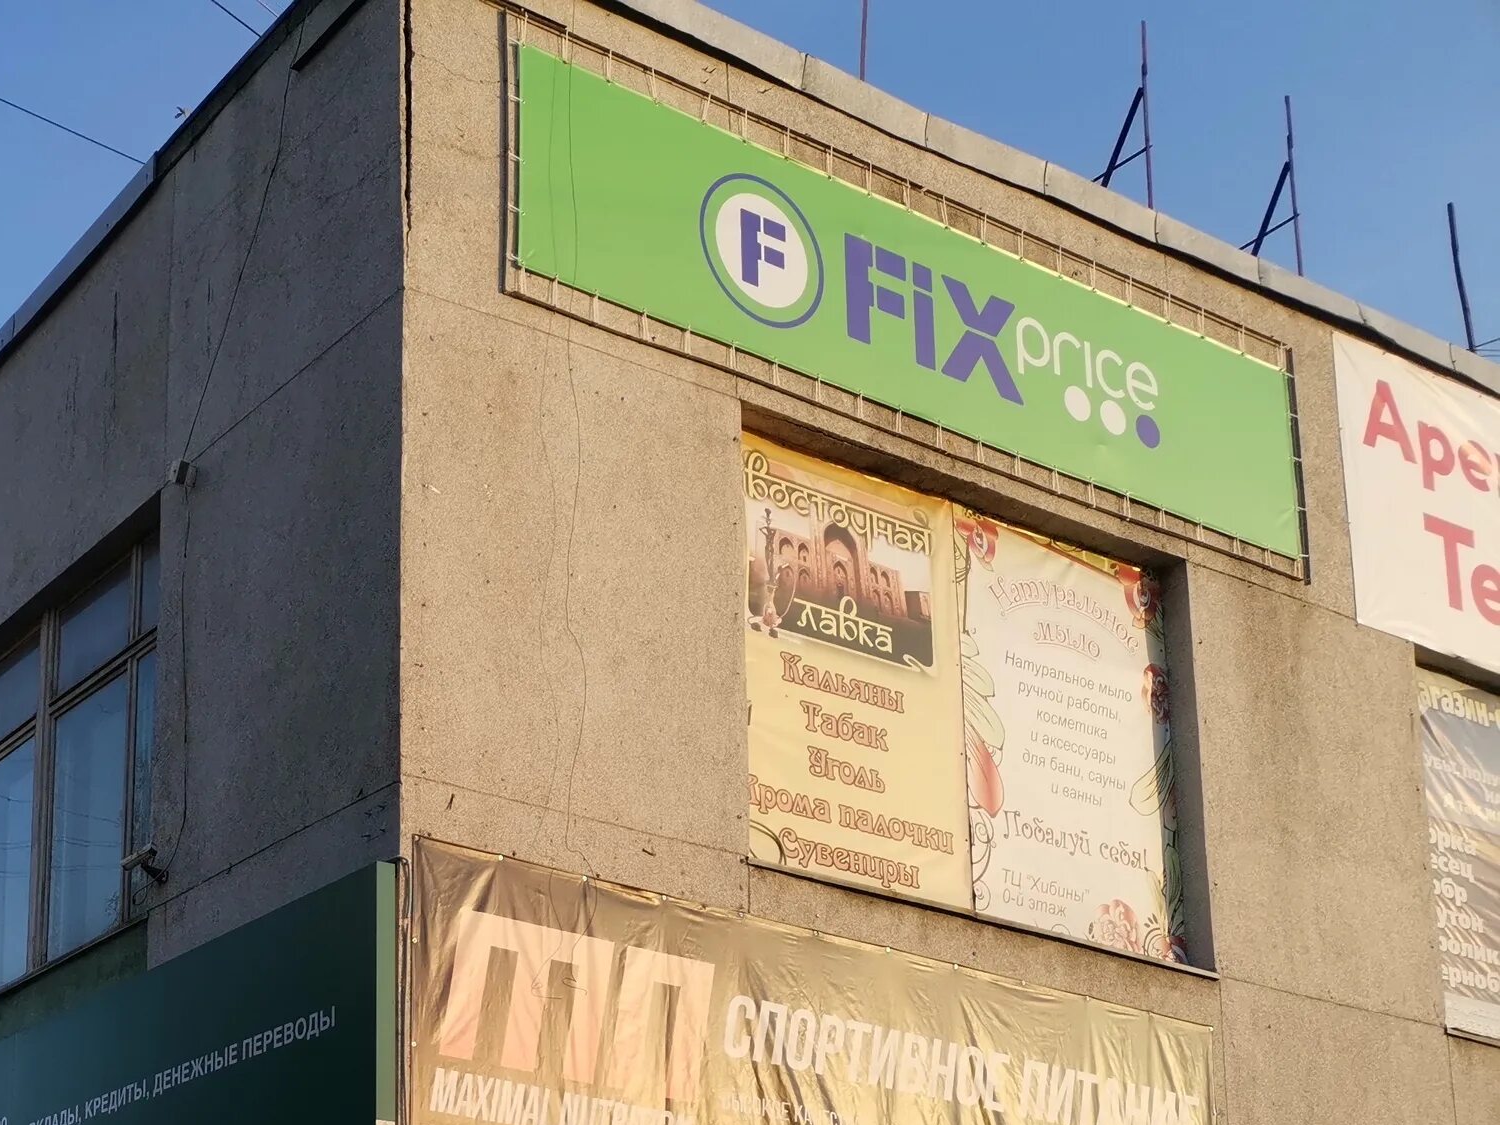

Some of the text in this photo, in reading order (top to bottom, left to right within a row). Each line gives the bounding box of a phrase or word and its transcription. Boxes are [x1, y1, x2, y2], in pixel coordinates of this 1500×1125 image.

[1015, 317, 1158, 411] price
[1363, 379, 1500, 492] Аре
[988, 575, 1140, 656] Натуральное
[780, 651, 904, 713] Кальяны
[1004, 650, 1133, 703] Натуральное мыло
[1018, 681, 1122, 723] ручной работы,
[800, 700, 889, 752] Табак
[1030, 730, 1116, 765] и аксессуары
[1036, 709, 1108, 740] косметика
[807, 745, 885, 793] Уголь
[1022, 748, 1126, 791] для бани, сауны
[1051, 783, 1102, 807] и ванны
[838, 803, 954, 856] палочки
[1003, 810, 1150, 872] Побалуй себя!
[779, 827, 920, 889] Сувениры
[1002, 868, 1022, 890] ТЦ
[1002, 888, 1067, 918] 0-й этаж
[85, 1078, 150, 1121] КРЕДИТЫ,
[152, 1043, 239, 1098] ДЕНЕЖНЫЕ
[242, 1005, 336, 1062] ПЕРЕВОДЫ
[723, 995, 1012, 1114] СПОРТИВНОЕ
